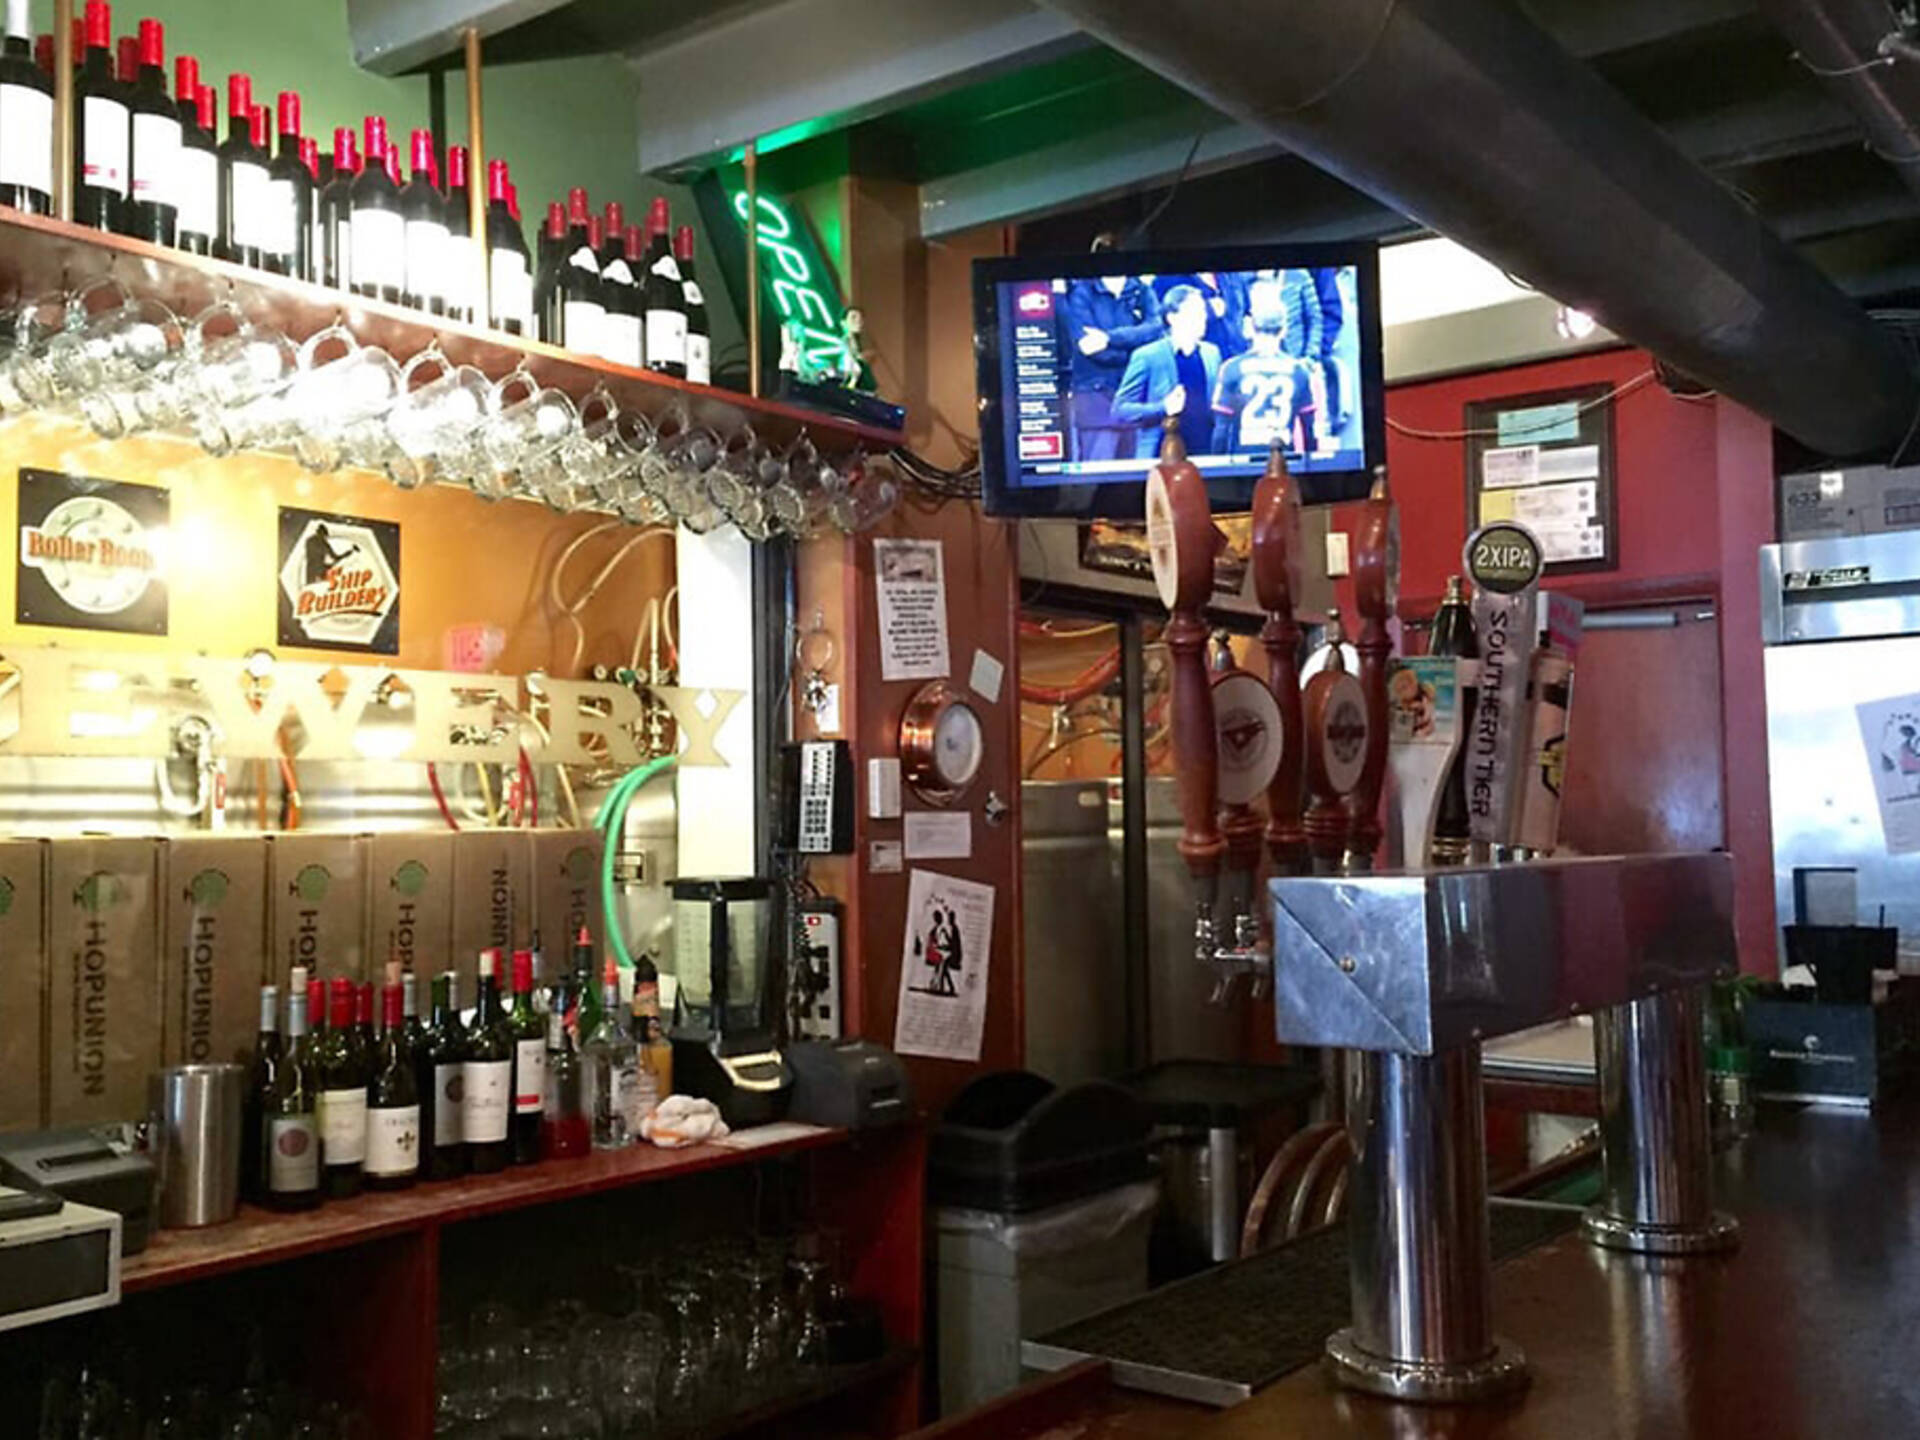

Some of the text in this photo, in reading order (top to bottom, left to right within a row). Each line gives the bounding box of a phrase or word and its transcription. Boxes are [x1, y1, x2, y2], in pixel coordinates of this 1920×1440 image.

[734, 191, 852, 368] OPEN
[1239, 374, 1295, 446] 23
[296, 585, 388, 616] BUILDERS
[325, 566, 374, 592] SHIP
[1476, 544, 1532, 569] 2XIPA
[1470, 610, 1509, 818] SOUTHERN TIER
[82, 920, 107, 1097] HOPUNION
[190, 916, 216, 1061] HOPUNIO
